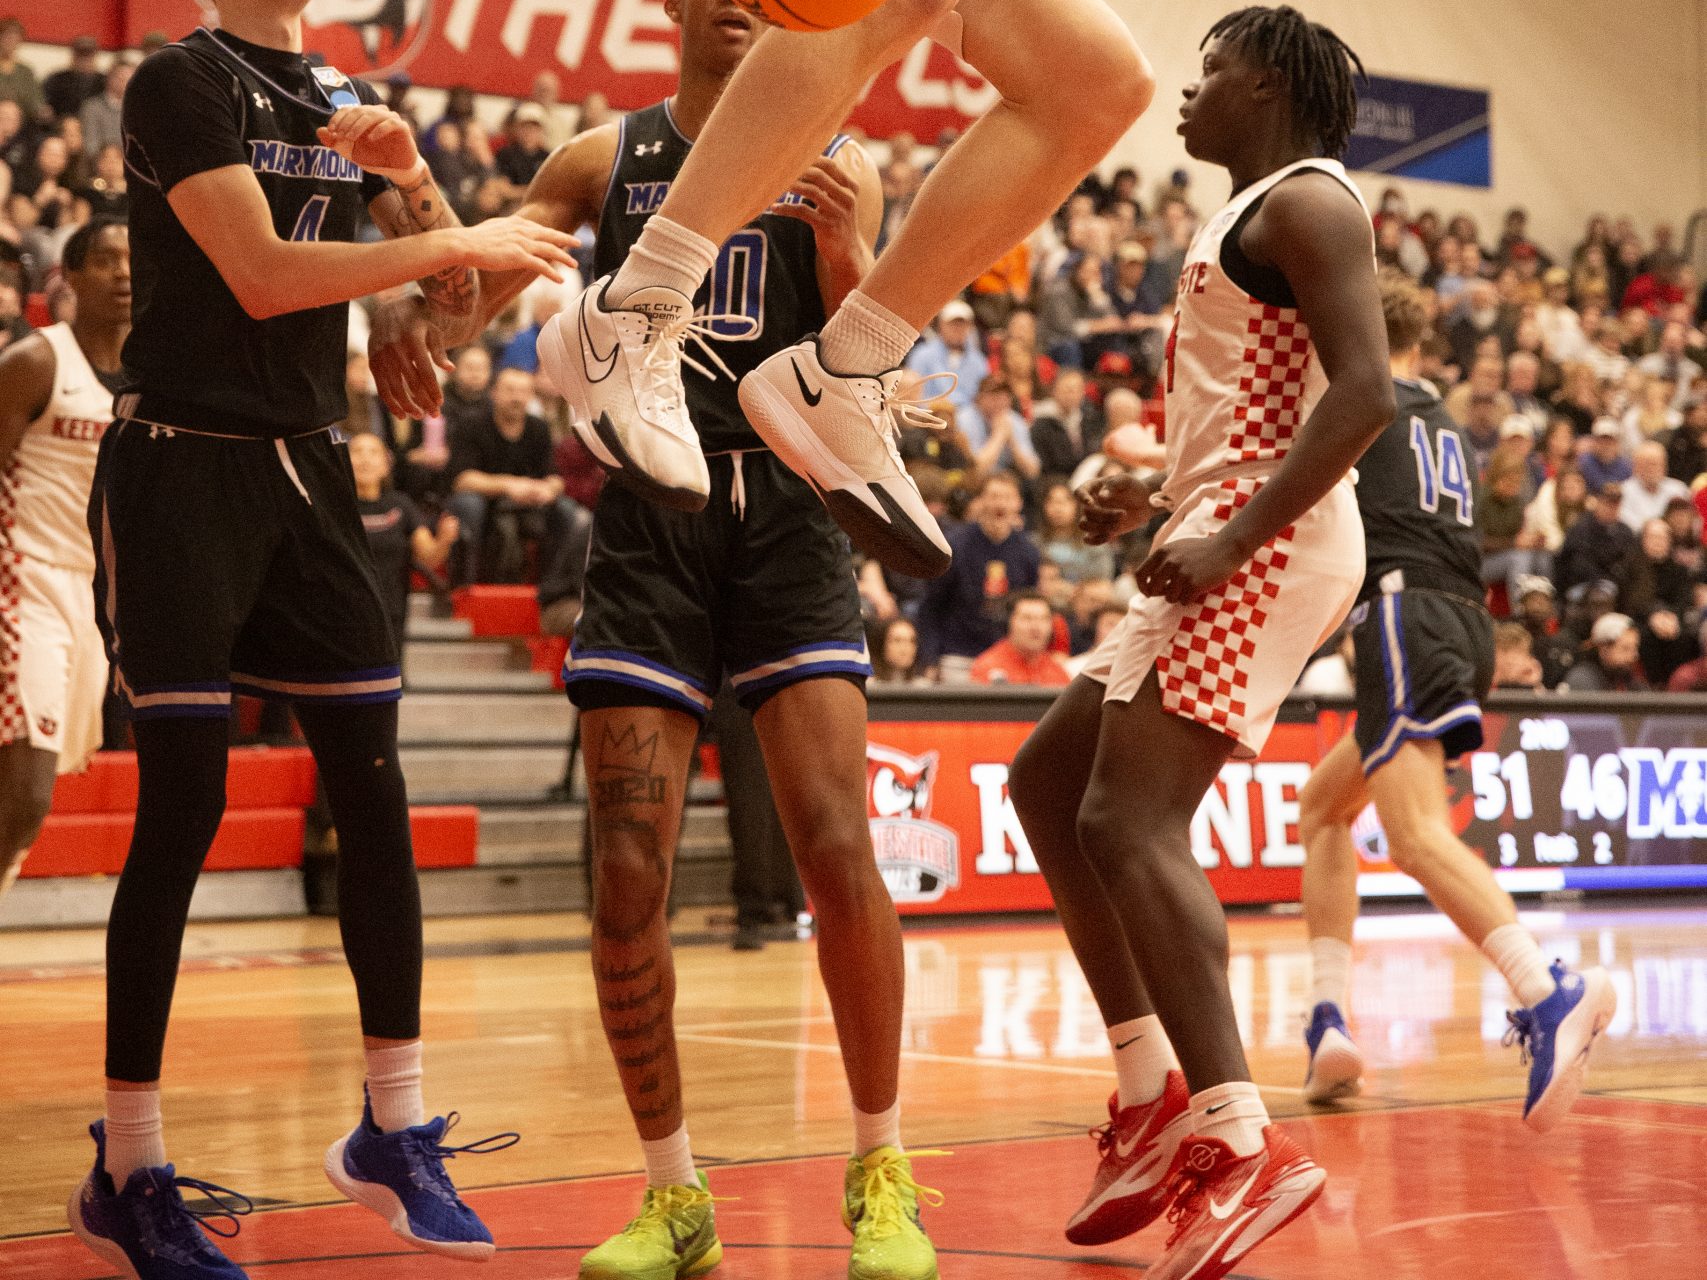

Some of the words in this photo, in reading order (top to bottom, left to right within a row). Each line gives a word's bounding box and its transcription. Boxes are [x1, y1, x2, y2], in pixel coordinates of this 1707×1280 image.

[248, 140, 364, 183] MARYMOUN
[654, 303, 683, 313] CUT
[53, 416, 110, 442] KEEN
[1409, 416, 1474, 526] 14
[1471, 752, 1533, 821] 51
[1560, 753, 1627, 821] 46
[970, 762, 1311, 875] KNE
